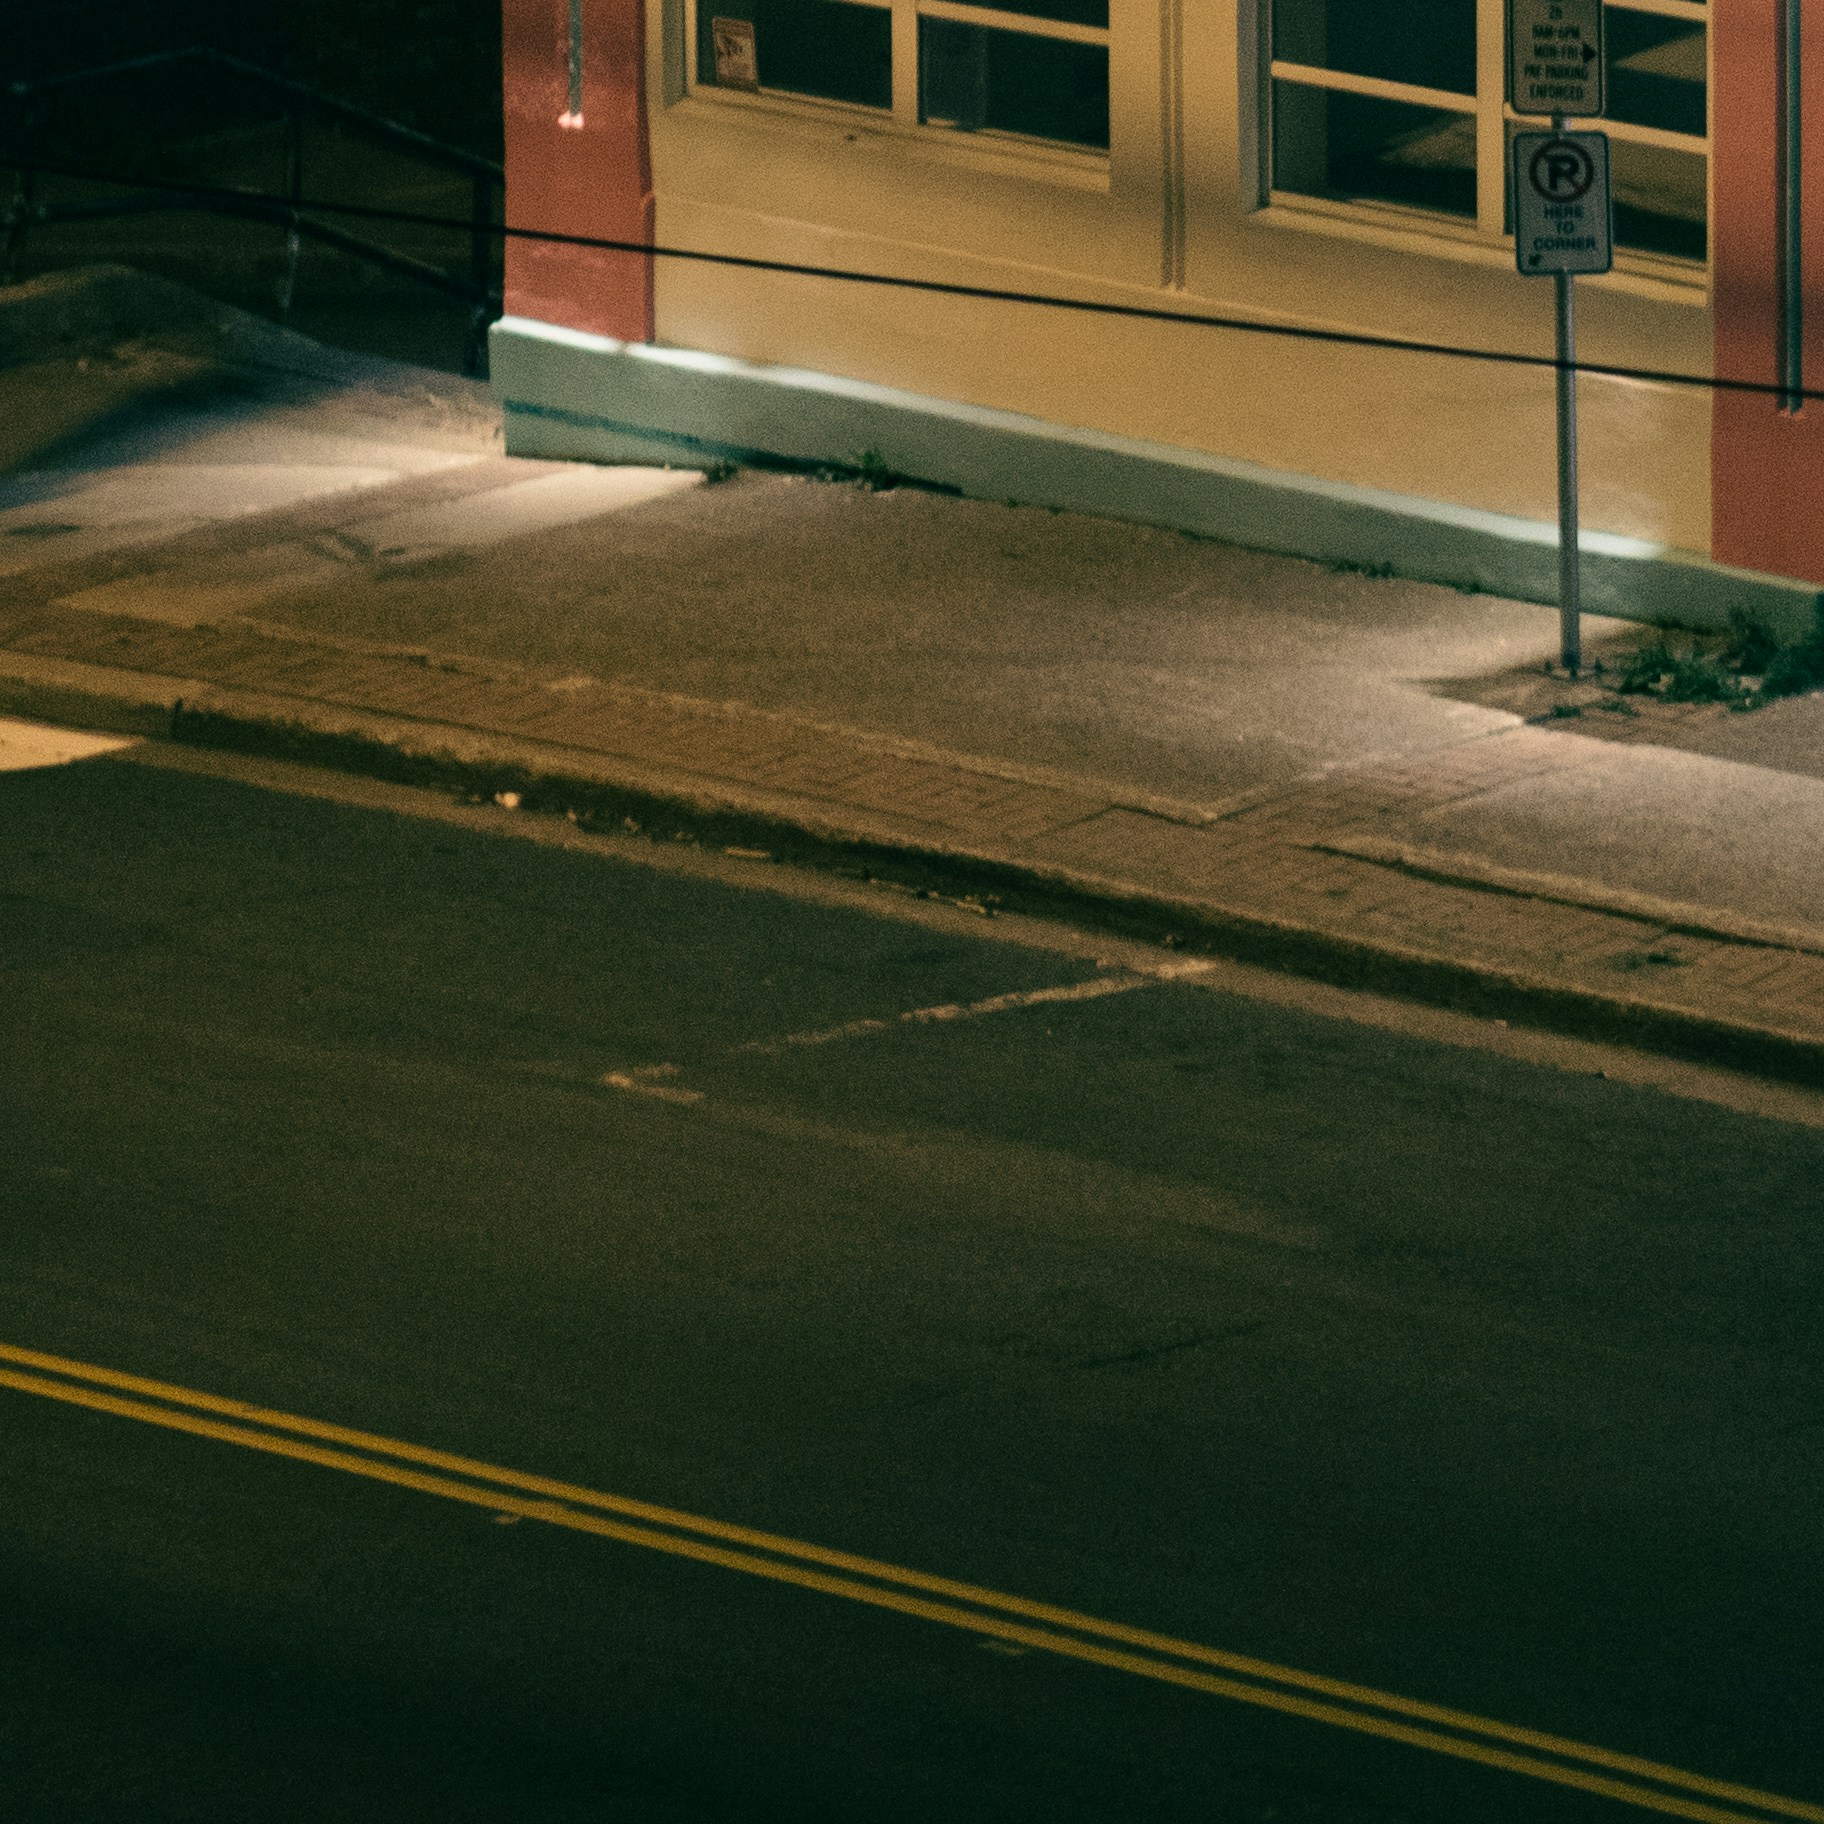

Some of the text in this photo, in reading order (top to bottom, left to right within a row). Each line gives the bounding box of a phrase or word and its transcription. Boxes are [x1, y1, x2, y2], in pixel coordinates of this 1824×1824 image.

[1545, 64, 1589, 82] PARKING
[1529, 83, 1585, 102] ENFORCED
[1543, 204, 1584, 219] HERE
[1556, 219, 1574, 234] TO
[1533, 236, 1596, 251] CORNER
